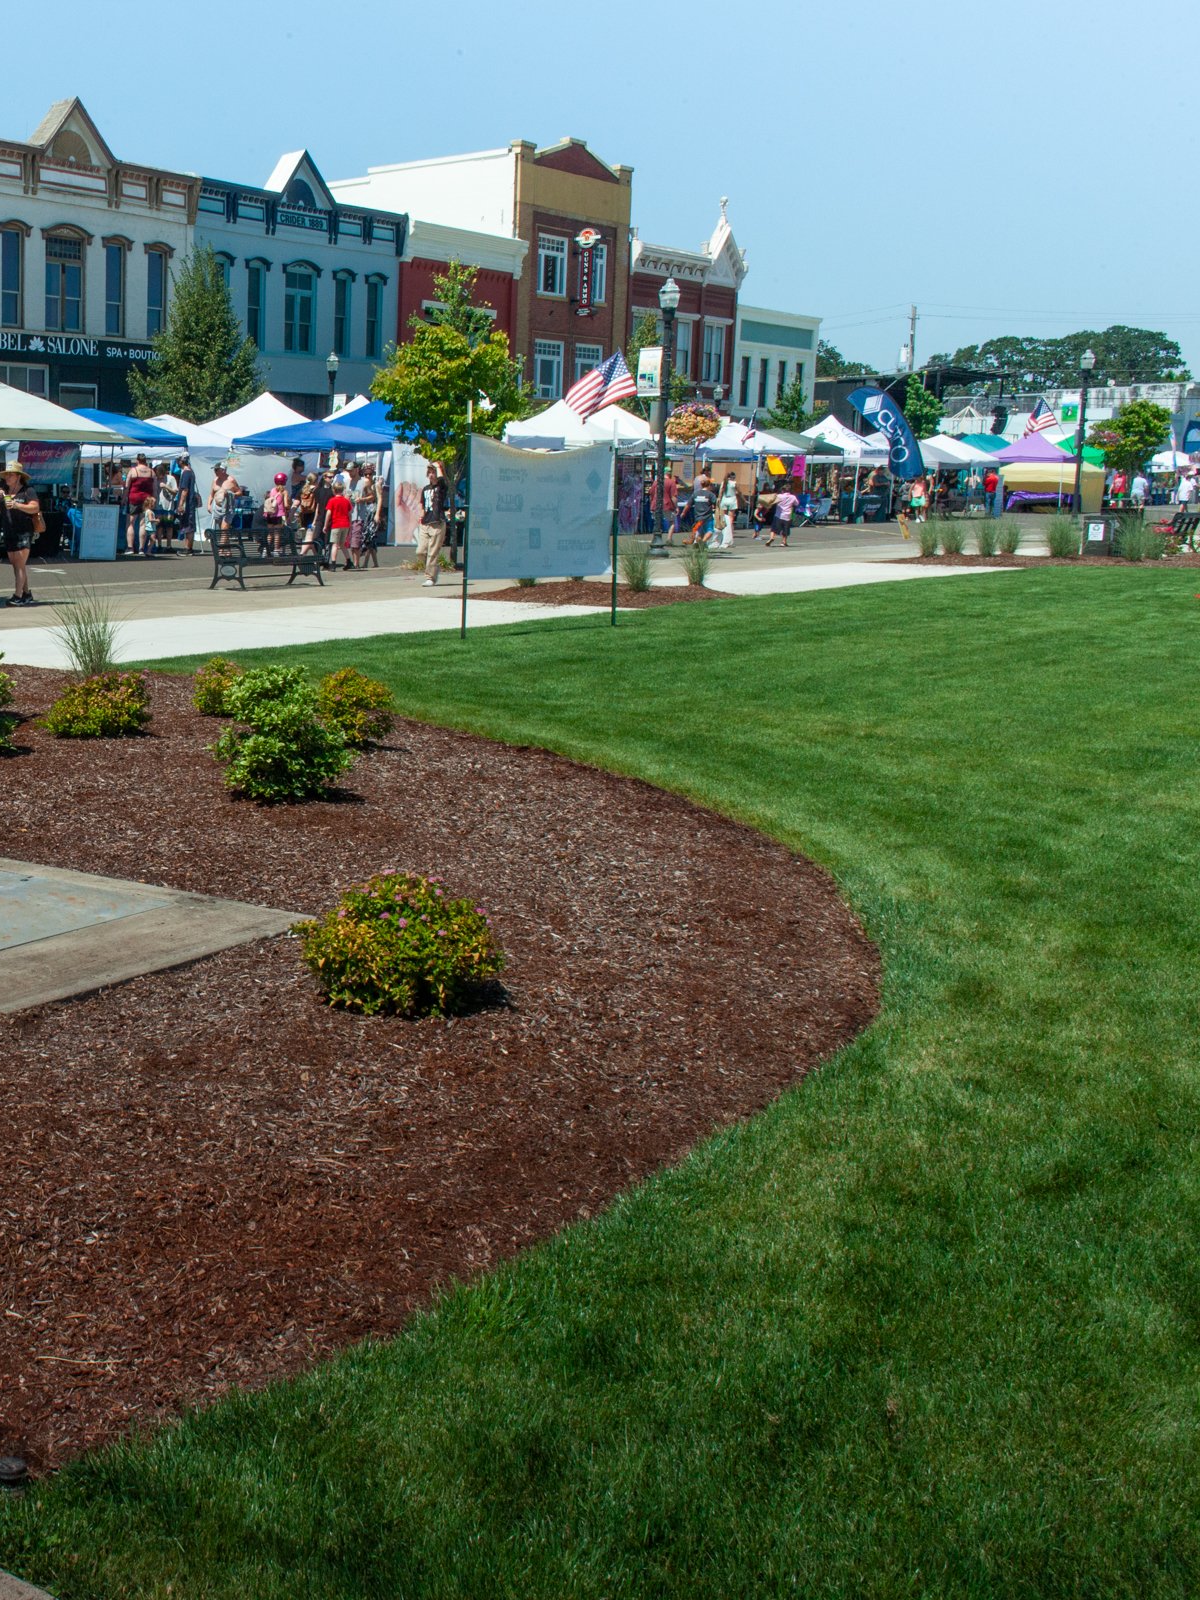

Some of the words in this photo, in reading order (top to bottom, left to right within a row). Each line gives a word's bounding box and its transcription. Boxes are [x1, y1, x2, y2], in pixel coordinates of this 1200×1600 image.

[280, 213, 306, 227] CRIDER
[47, 336, 99, 357] SALONE
[106, 346, 123, 359] SPA
